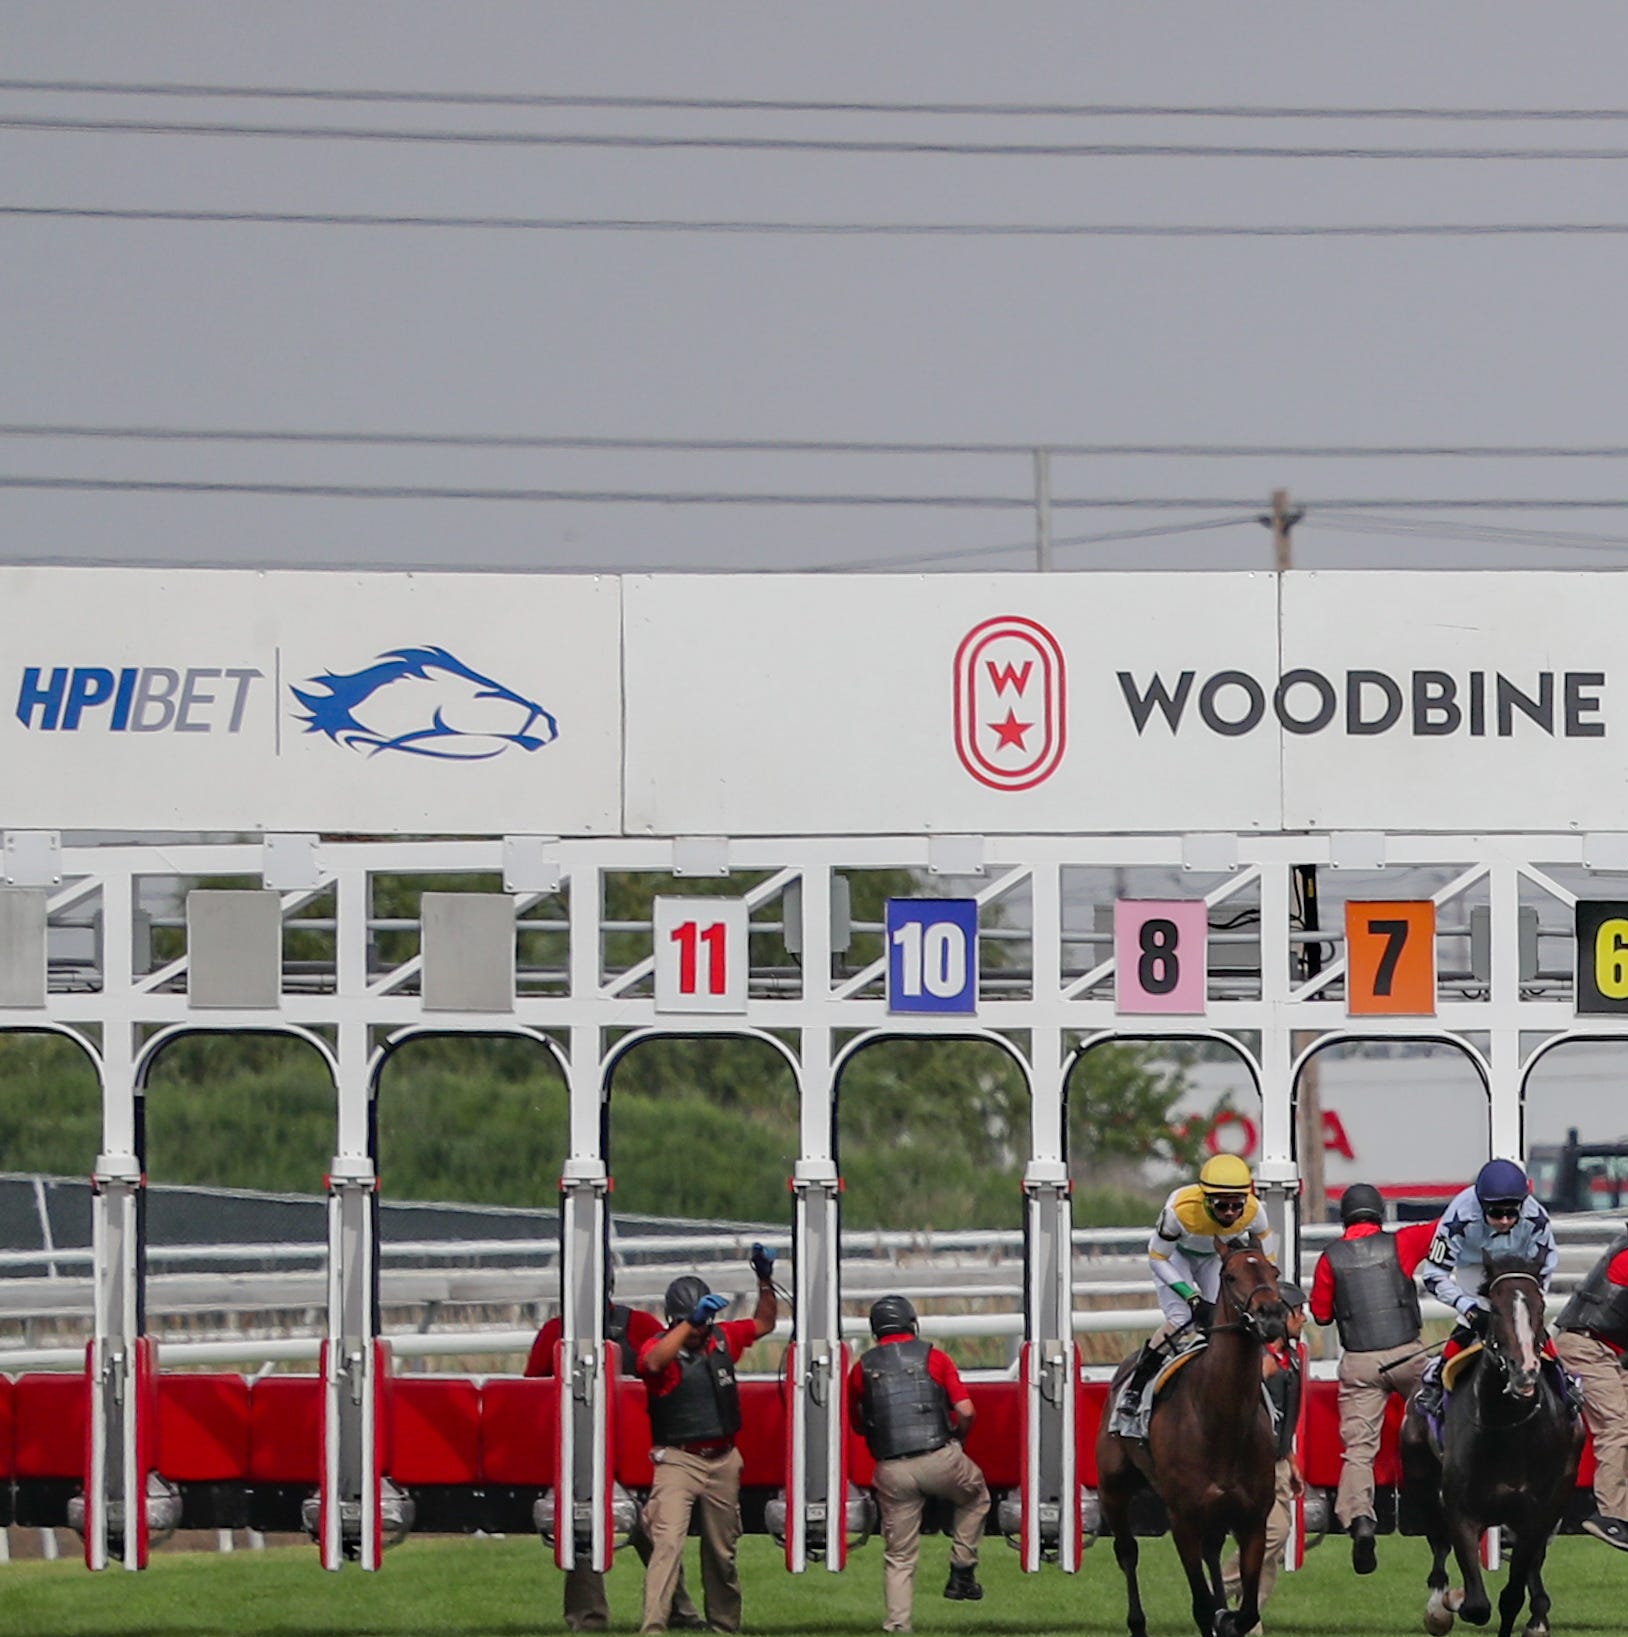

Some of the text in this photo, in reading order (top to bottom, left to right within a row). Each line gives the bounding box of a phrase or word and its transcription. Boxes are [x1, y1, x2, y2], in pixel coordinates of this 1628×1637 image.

[15, 666, 264, 732] HPIBET
[987, 661, 1033, 696] W
[1117, 669, 1606, 737] WOODBINE
[671, 921, 727, 996] 11
[893, 921, 967, 998] 10
[1137, 918, 1179, 996] 8
[1366, 918, 1410, 997] 7
[1429, 1239, 1447, 1263] 10
